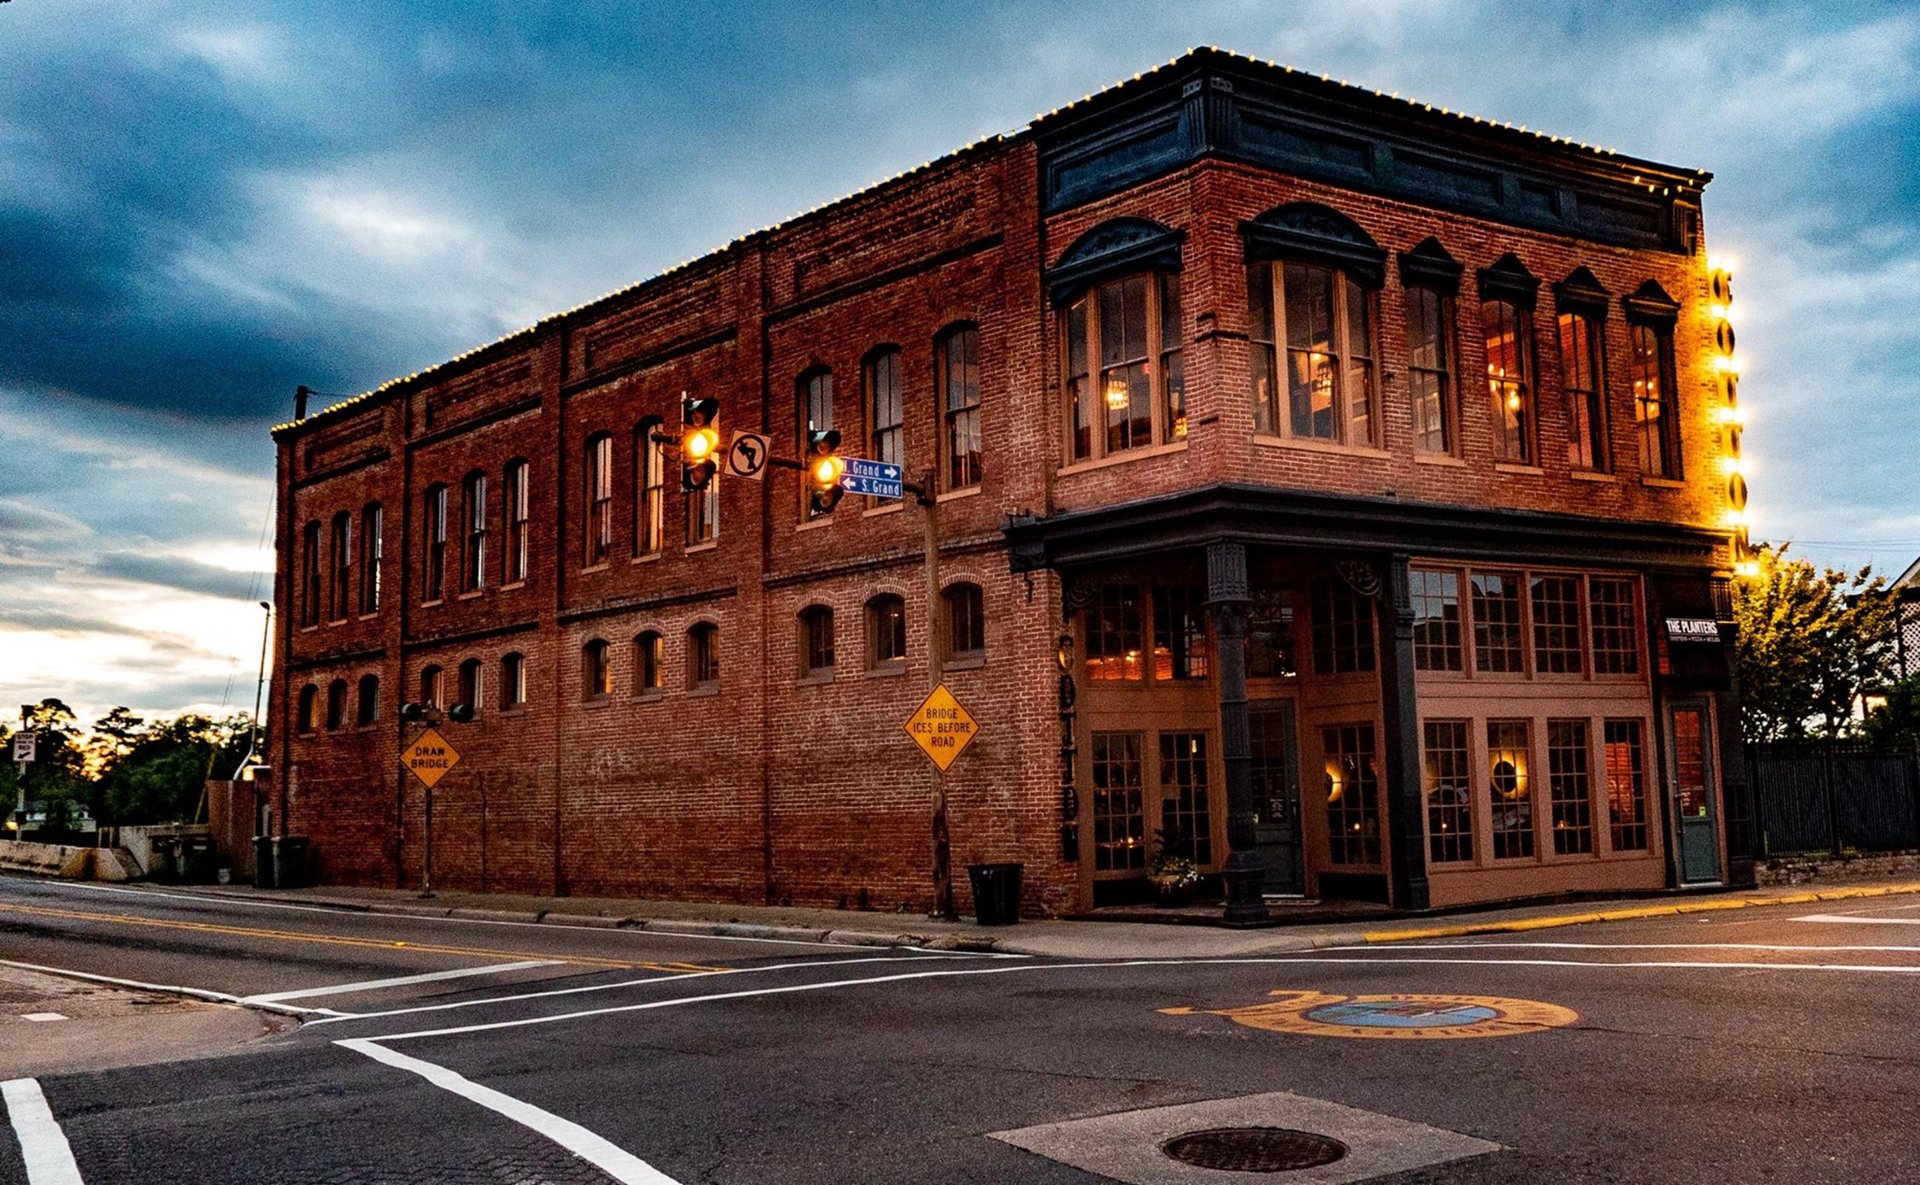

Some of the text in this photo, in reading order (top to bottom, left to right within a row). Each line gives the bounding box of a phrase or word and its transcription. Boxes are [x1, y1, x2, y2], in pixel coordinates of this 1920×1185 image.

[853, 461, 880, 477] Grand
[862, 479, 900, 496] S. Grand
[1665, 620, 1719, 635] THE PLANTERS
[926, 708, 958, 719] BRIDGE
[913, 722, 971, 734] ICES BEFORE
[931, 736, 955, 748] ROAD
[415, 746, 445, 757] DRAW
[410, 758, 449, 769] BRIDGE
